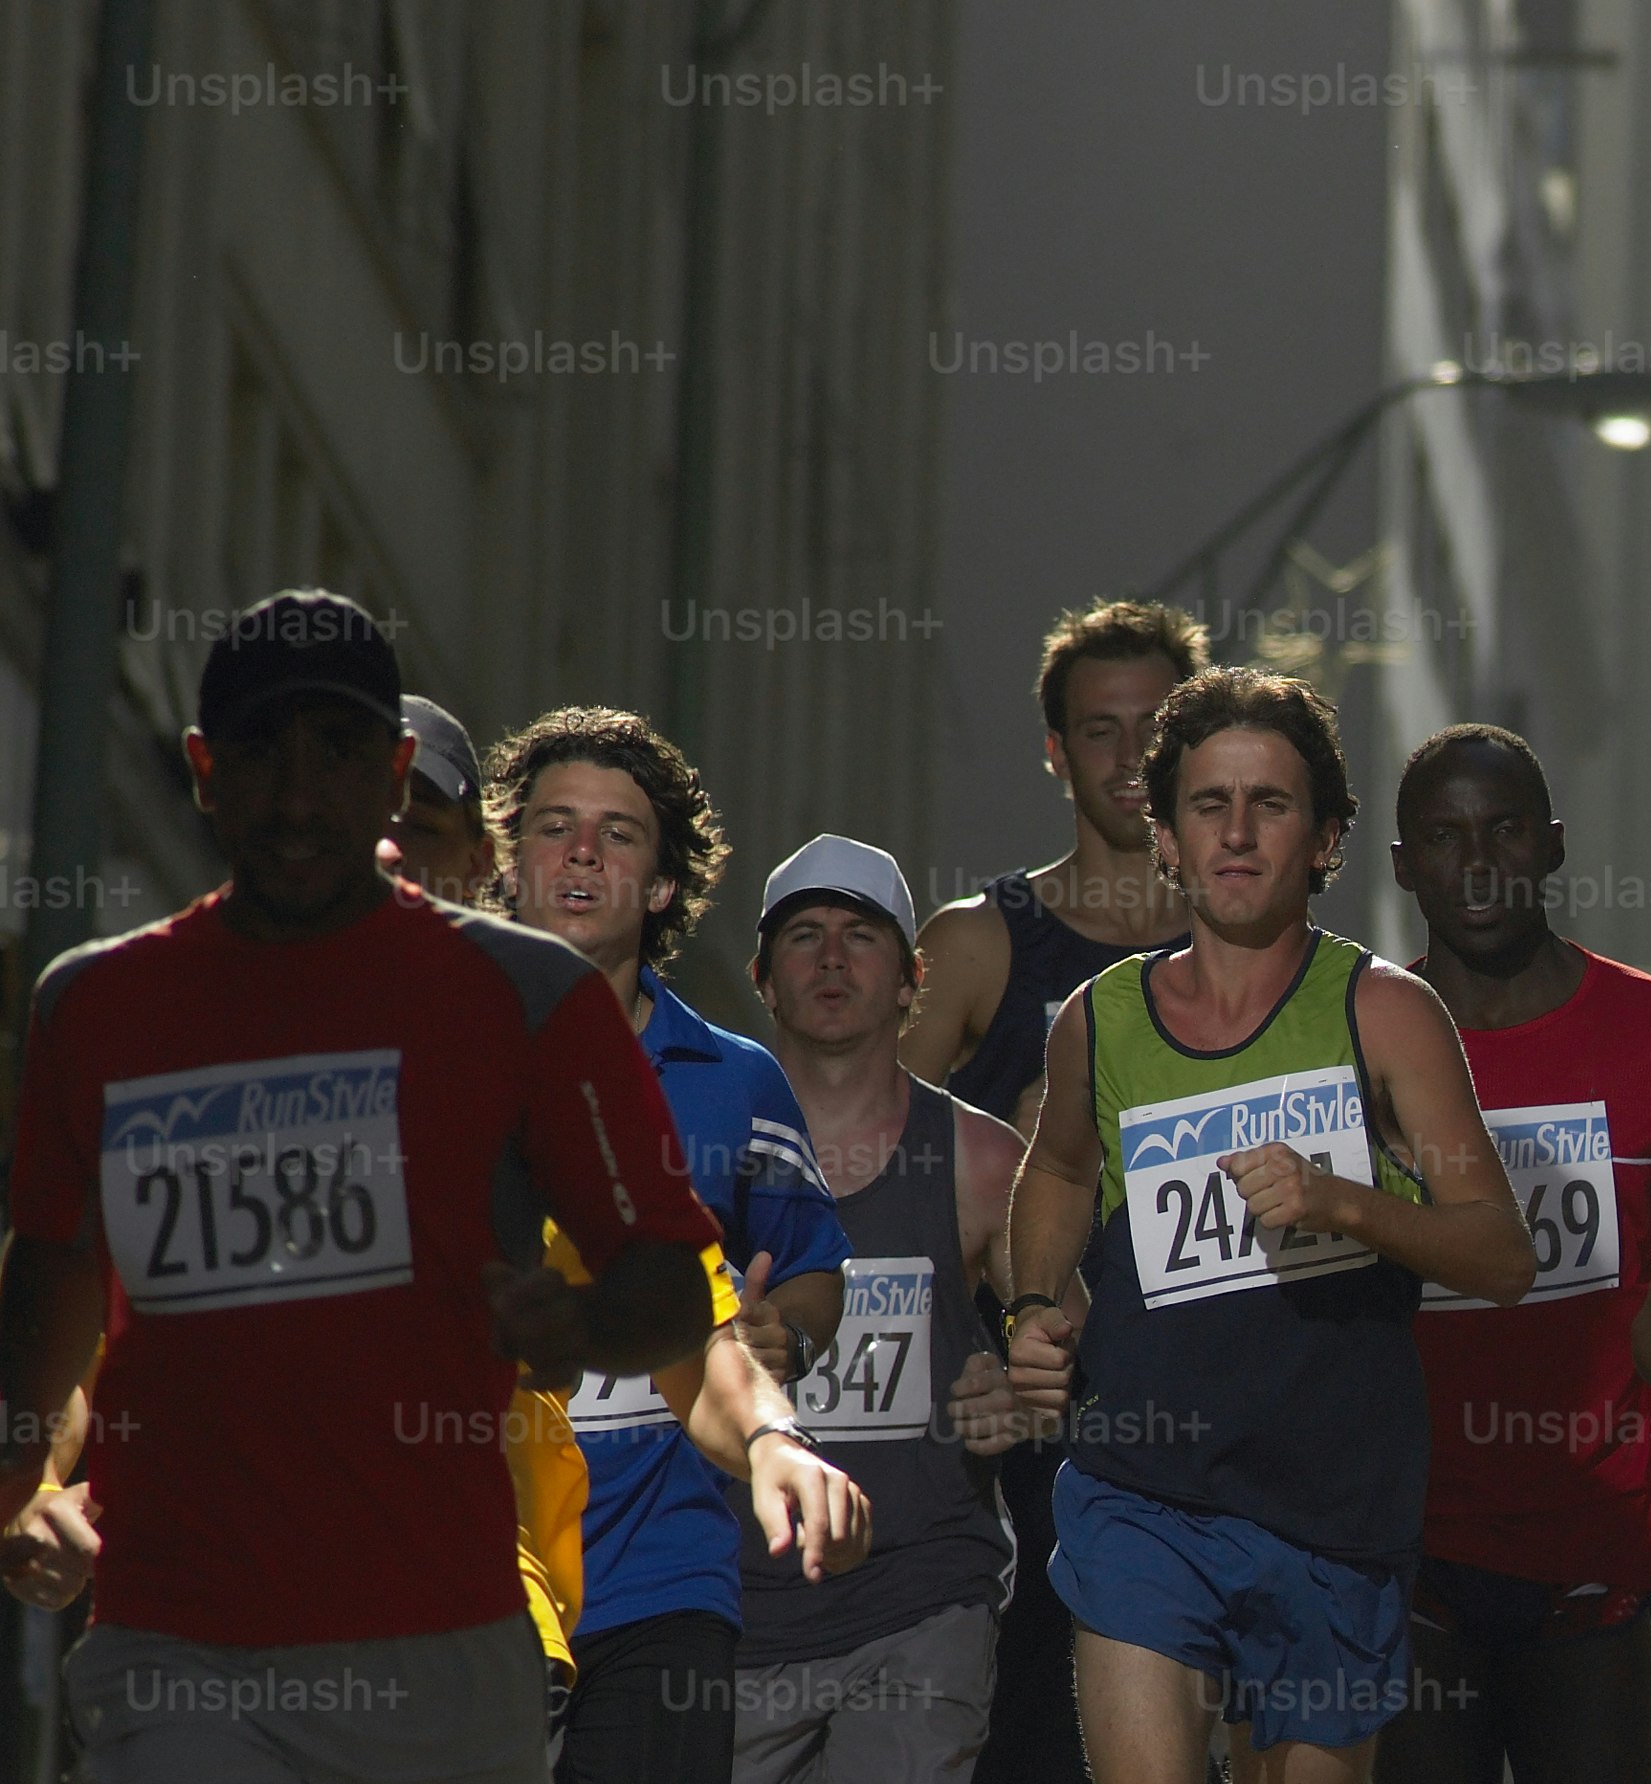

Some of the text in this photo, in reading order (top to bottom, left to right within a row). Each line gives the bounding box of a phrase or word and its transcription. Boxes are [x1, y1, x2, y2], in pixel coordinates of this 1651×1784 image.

[236, 1066, 396, 1132] RunStyle
[1231, 1083, 1362, 1149] RunStyle
[136, 1141, 376, 1278] 21586
[844, 1272, 932, 1317] nStyle
[788, 1332, 912, 1413] 347
